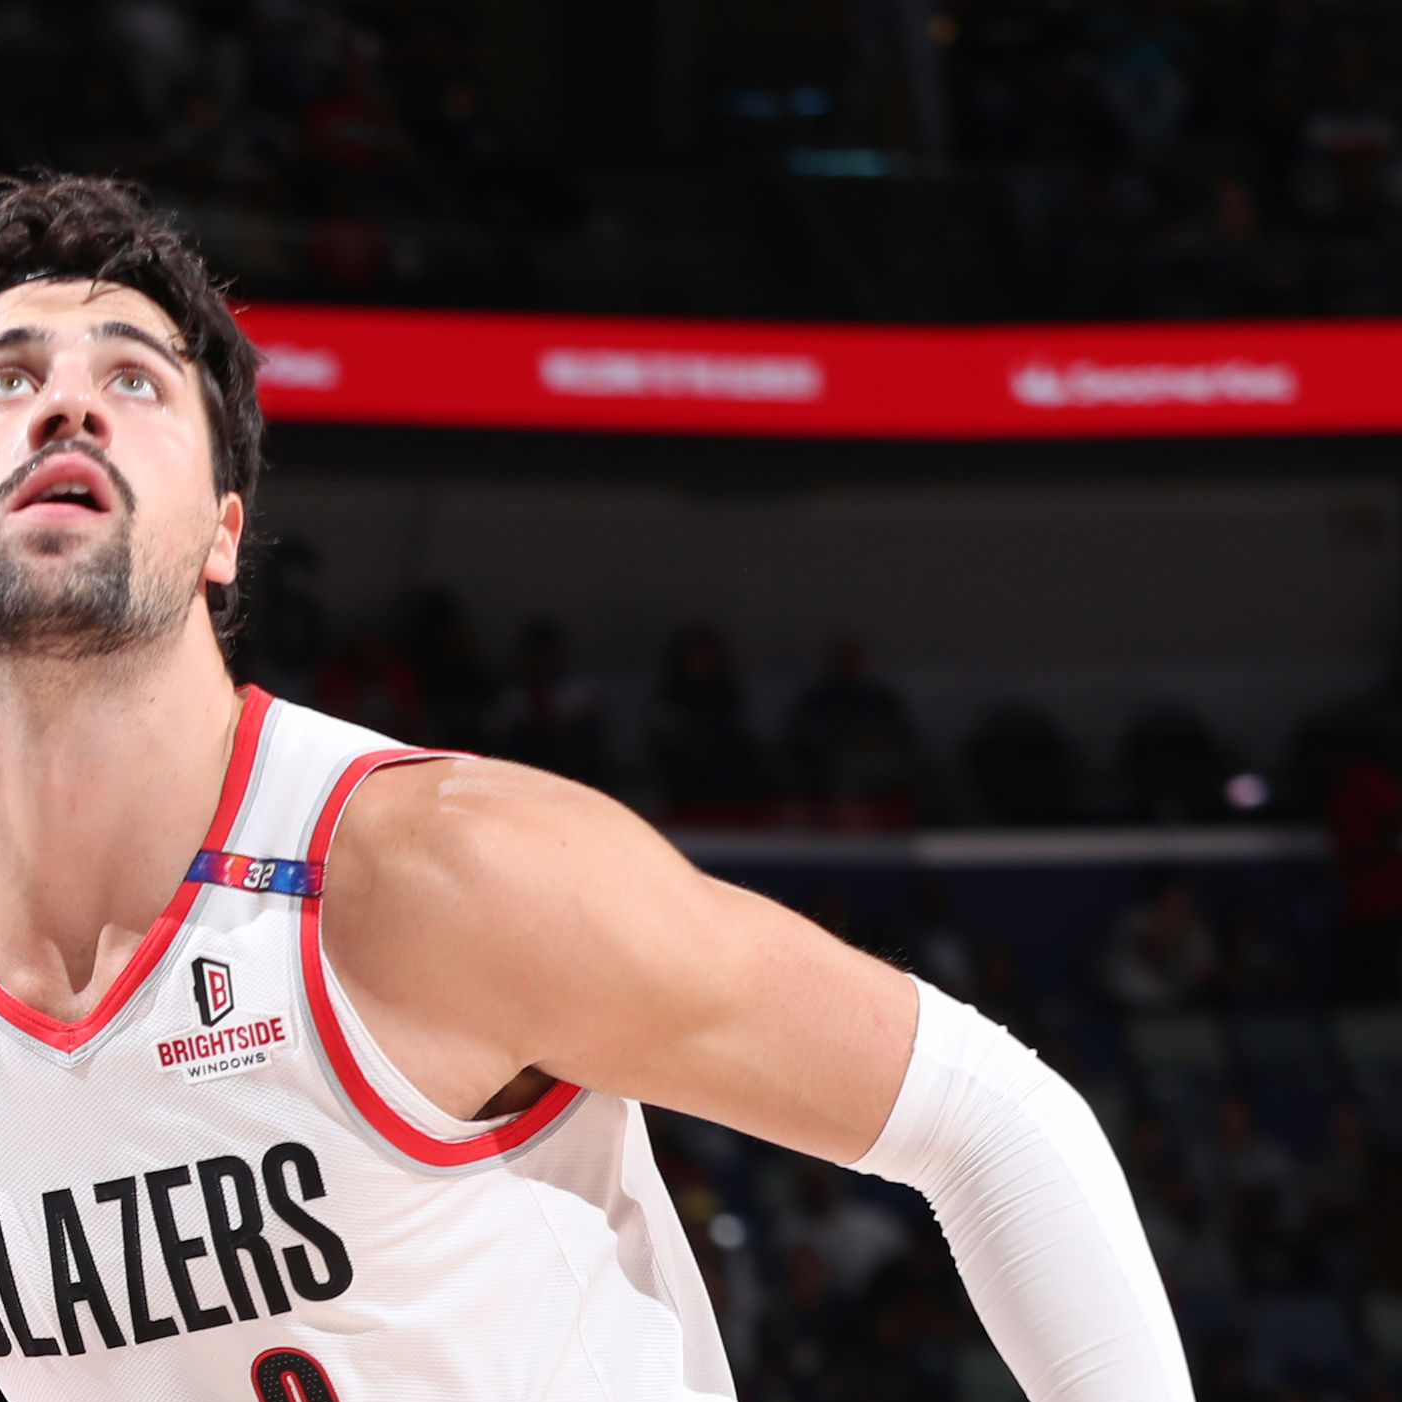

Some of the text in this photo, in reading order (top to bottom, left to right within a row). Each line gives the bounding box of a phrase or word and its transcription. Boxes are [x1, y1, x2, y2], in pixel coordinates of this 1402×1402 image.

[243, 862, 276, 890] 32
[208, 969, 227, 1012] B
[158, 1017, 286, 1068] BRIGHTSIDE
[188, 1052, 267, 1078] WINDOWS
